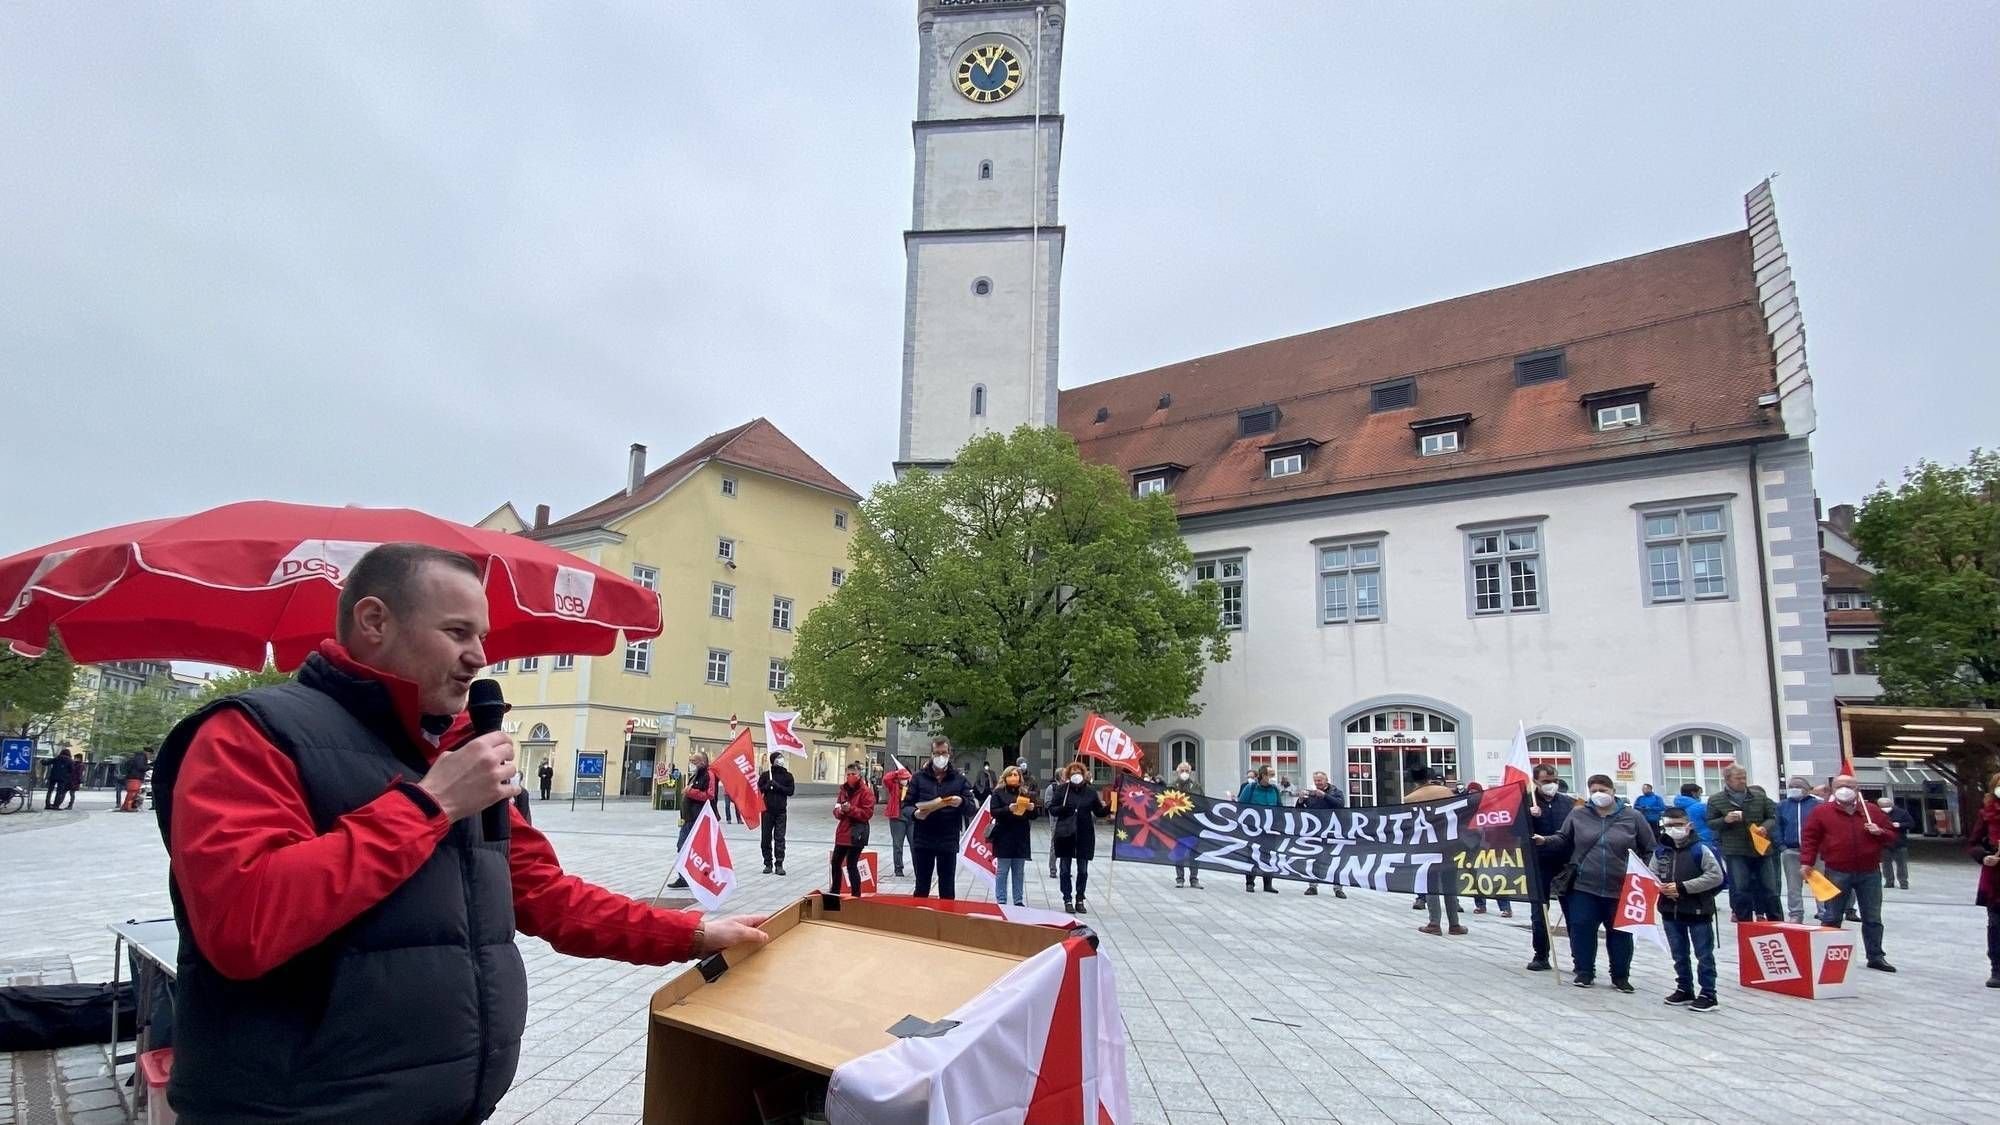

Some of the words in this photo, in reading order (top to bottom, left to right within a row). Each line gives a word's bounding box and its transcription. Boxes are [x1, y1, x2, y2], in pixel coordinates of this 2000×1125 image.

[282, 558, 340, 579] DGB
[555, 593, 585, 613] DGB
[501, 720, 521, 732] NLY
[632, 717, 659, 729] ONL
[1372, 736, 1416, 744] Sparkasse
[733, 754, 754, 775] DIE
[1193, 799, 1468, 845] SOLIDARITÄT
[1476, 811, 1512, 826] DGB
[1278, 836, 1356, 856] IST
[1194, 829, 1443, 894] ZUKUNFT
[1459, 873, 1528, 896] 2021
[1757, 941, 1780, 975] ARBEIT
[1768, 939, 1792, 975] GUTE
